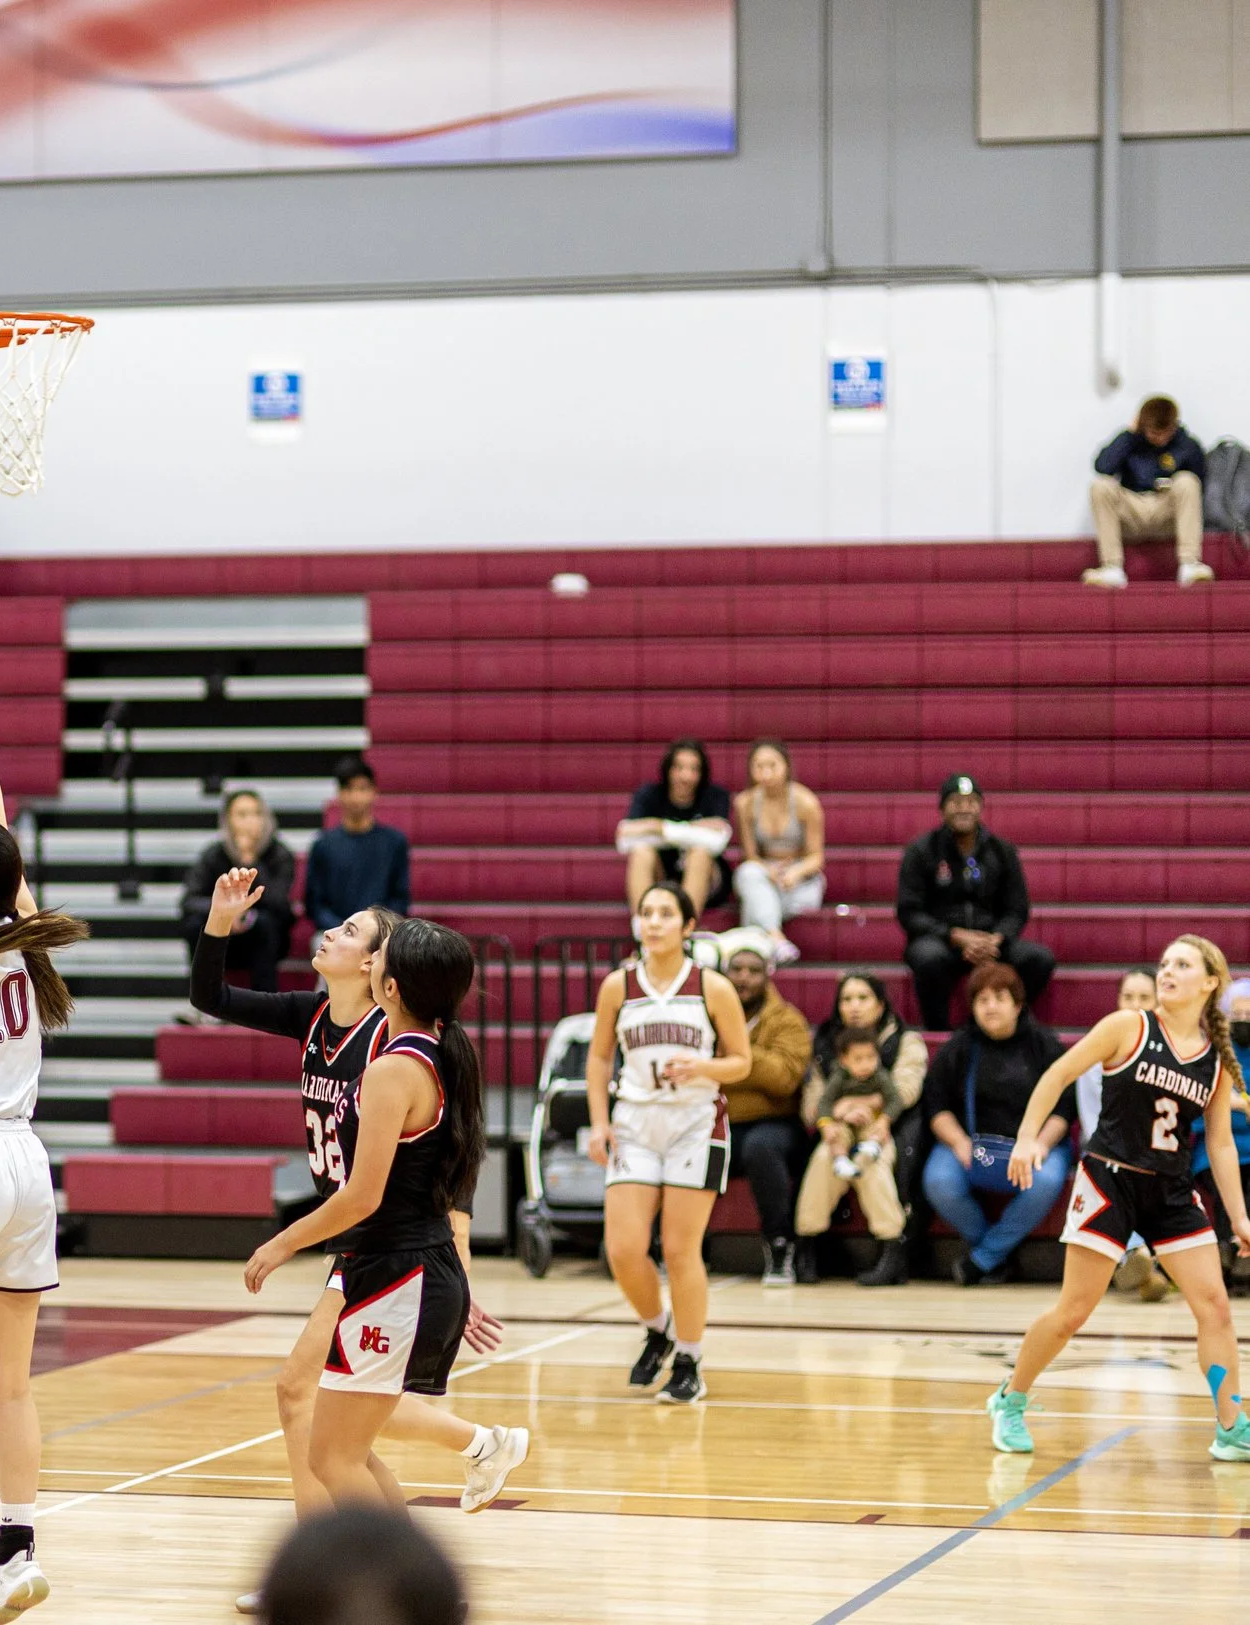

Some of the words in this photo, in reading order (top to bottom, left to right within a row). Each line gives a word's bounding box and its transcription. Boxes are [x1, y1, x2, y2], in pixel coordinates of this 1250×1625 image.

[1134, 1060, 1210, 1108] CARDINALS
[305, 1108, 347, 1190] 32
[1150, 1096, 1180, 1152] 2
[359, 1325, 390, 1354] MG
